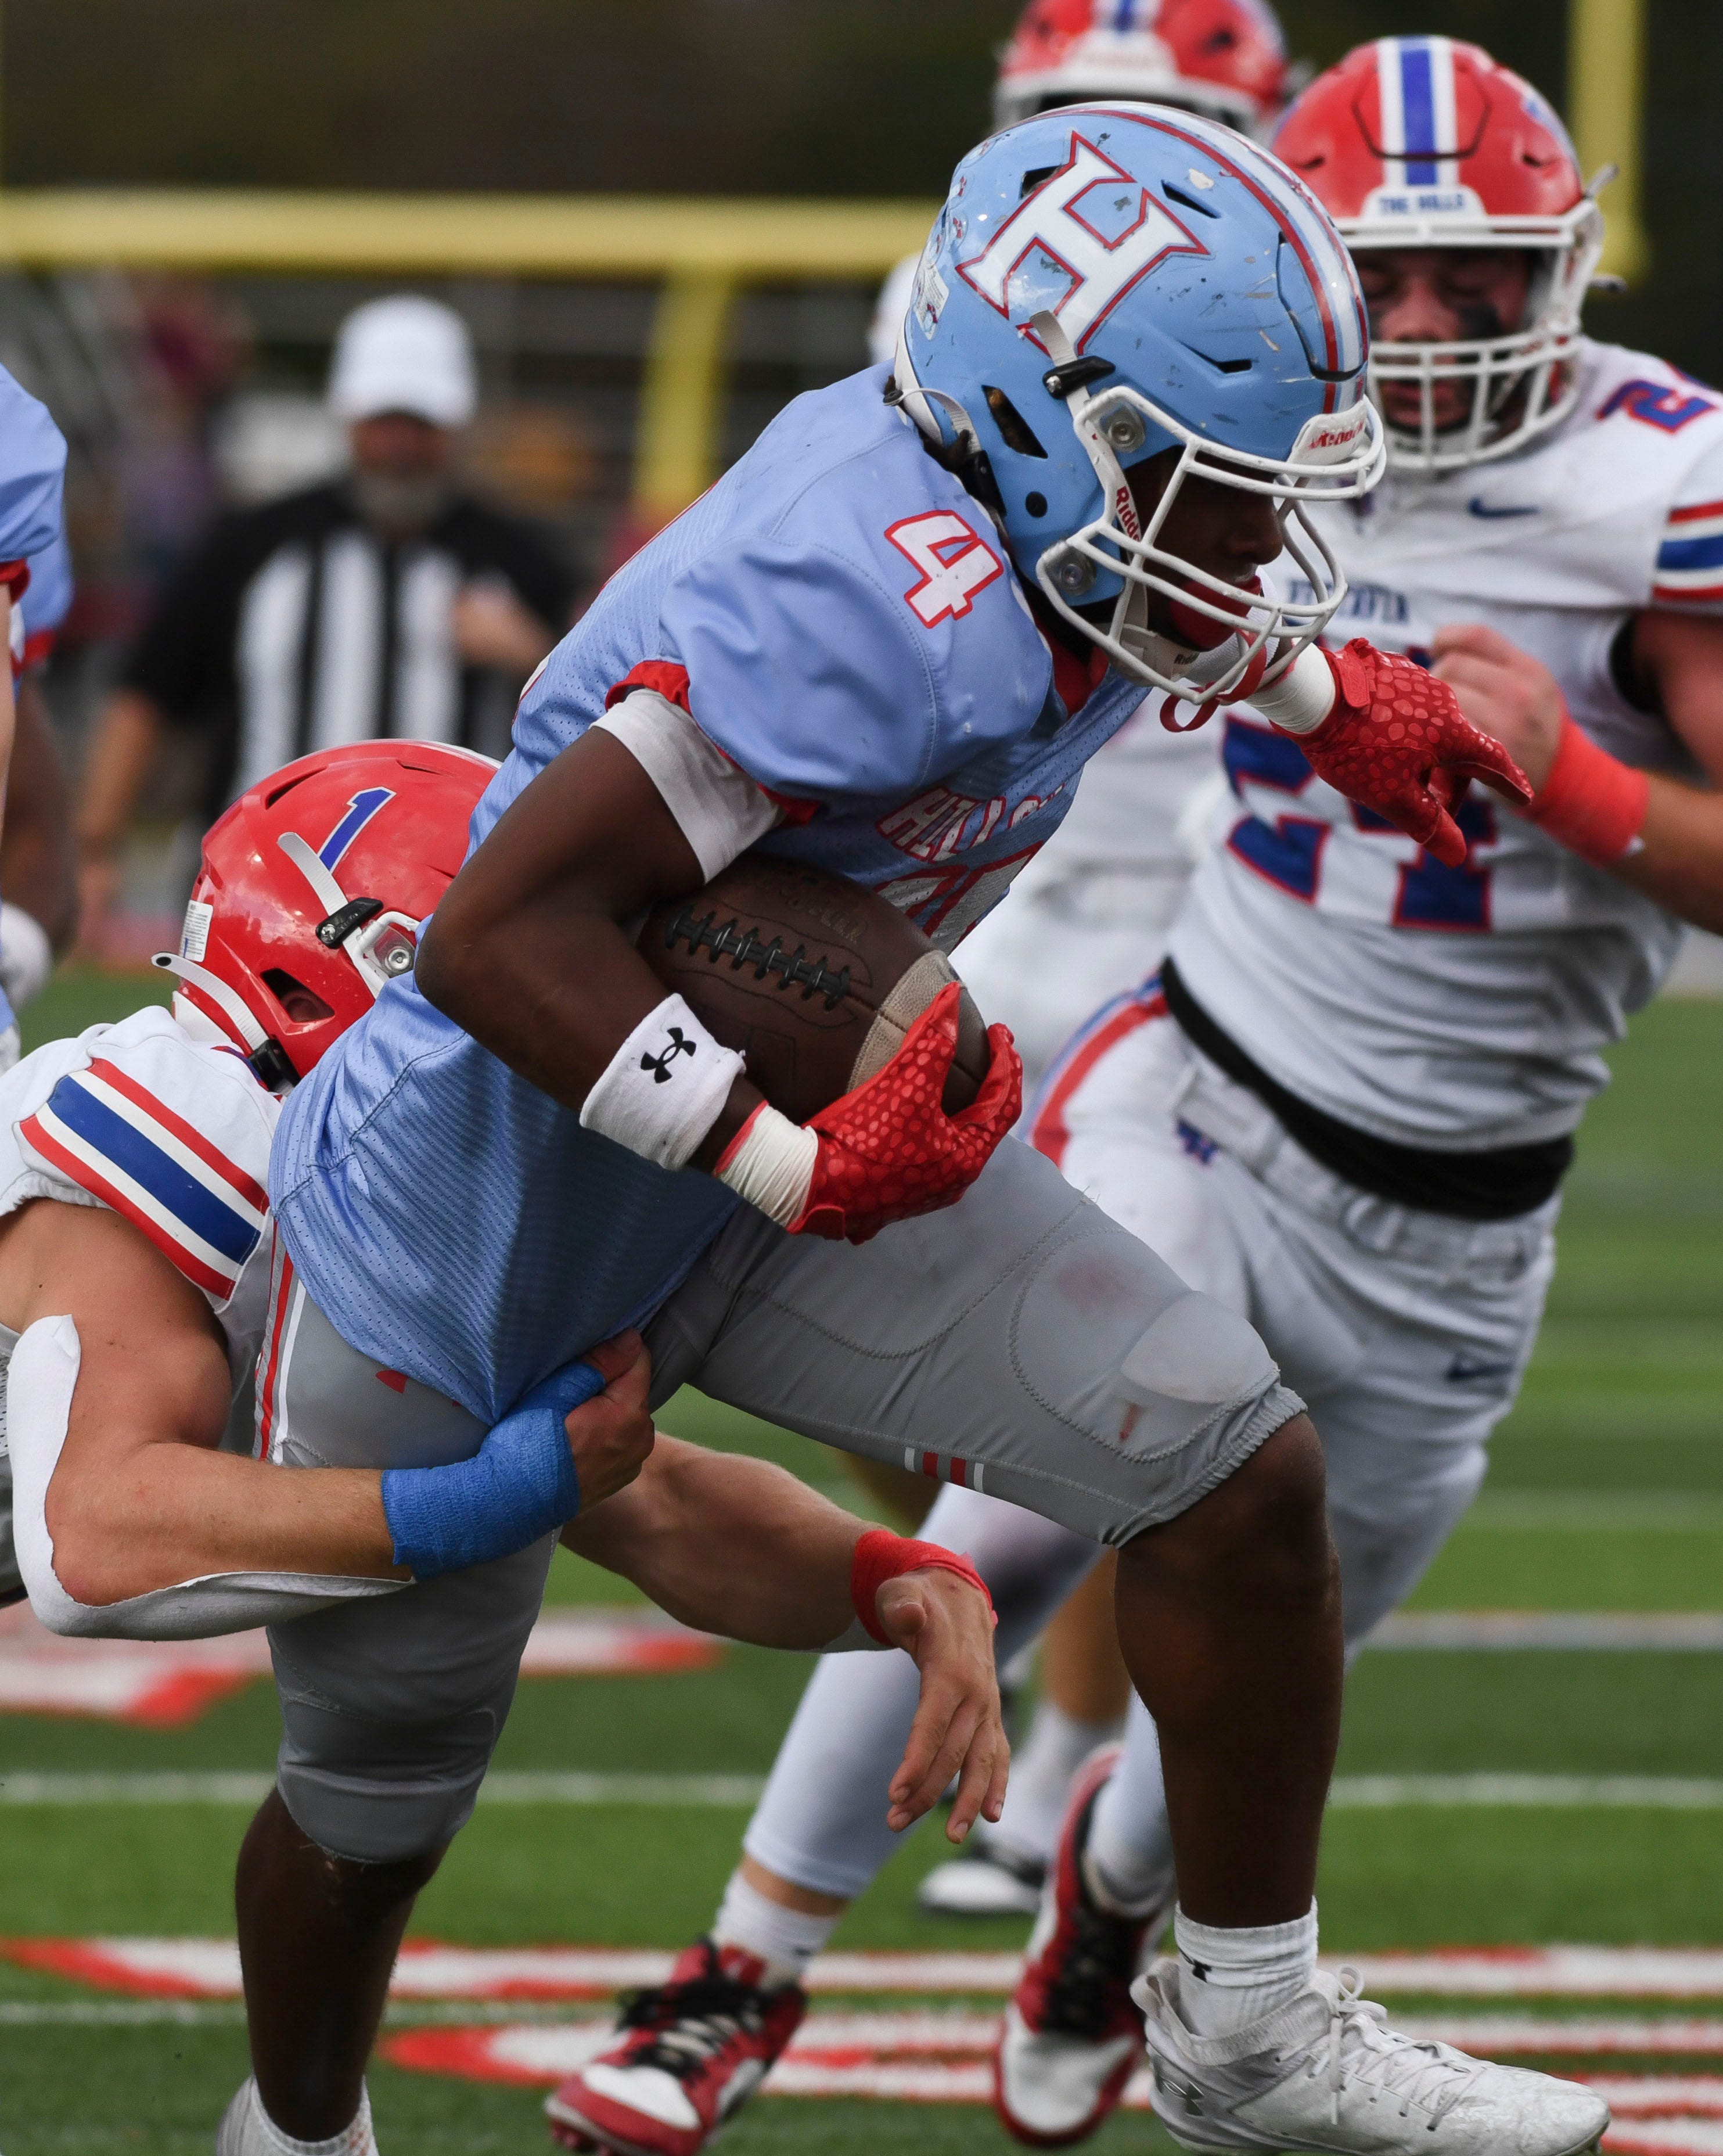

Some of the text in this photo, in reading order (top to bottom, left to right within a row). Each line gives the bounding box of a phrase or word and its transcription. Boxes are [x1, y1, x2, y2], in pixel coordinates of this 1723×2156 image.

[955, 129, 1211, 355] H
[1594, 360, 1717, 435] 2
[1116, 486, 1141, 542] Ridd
[885, 509, 1004, 628] 4
[316, 786, 397, 872] 1
